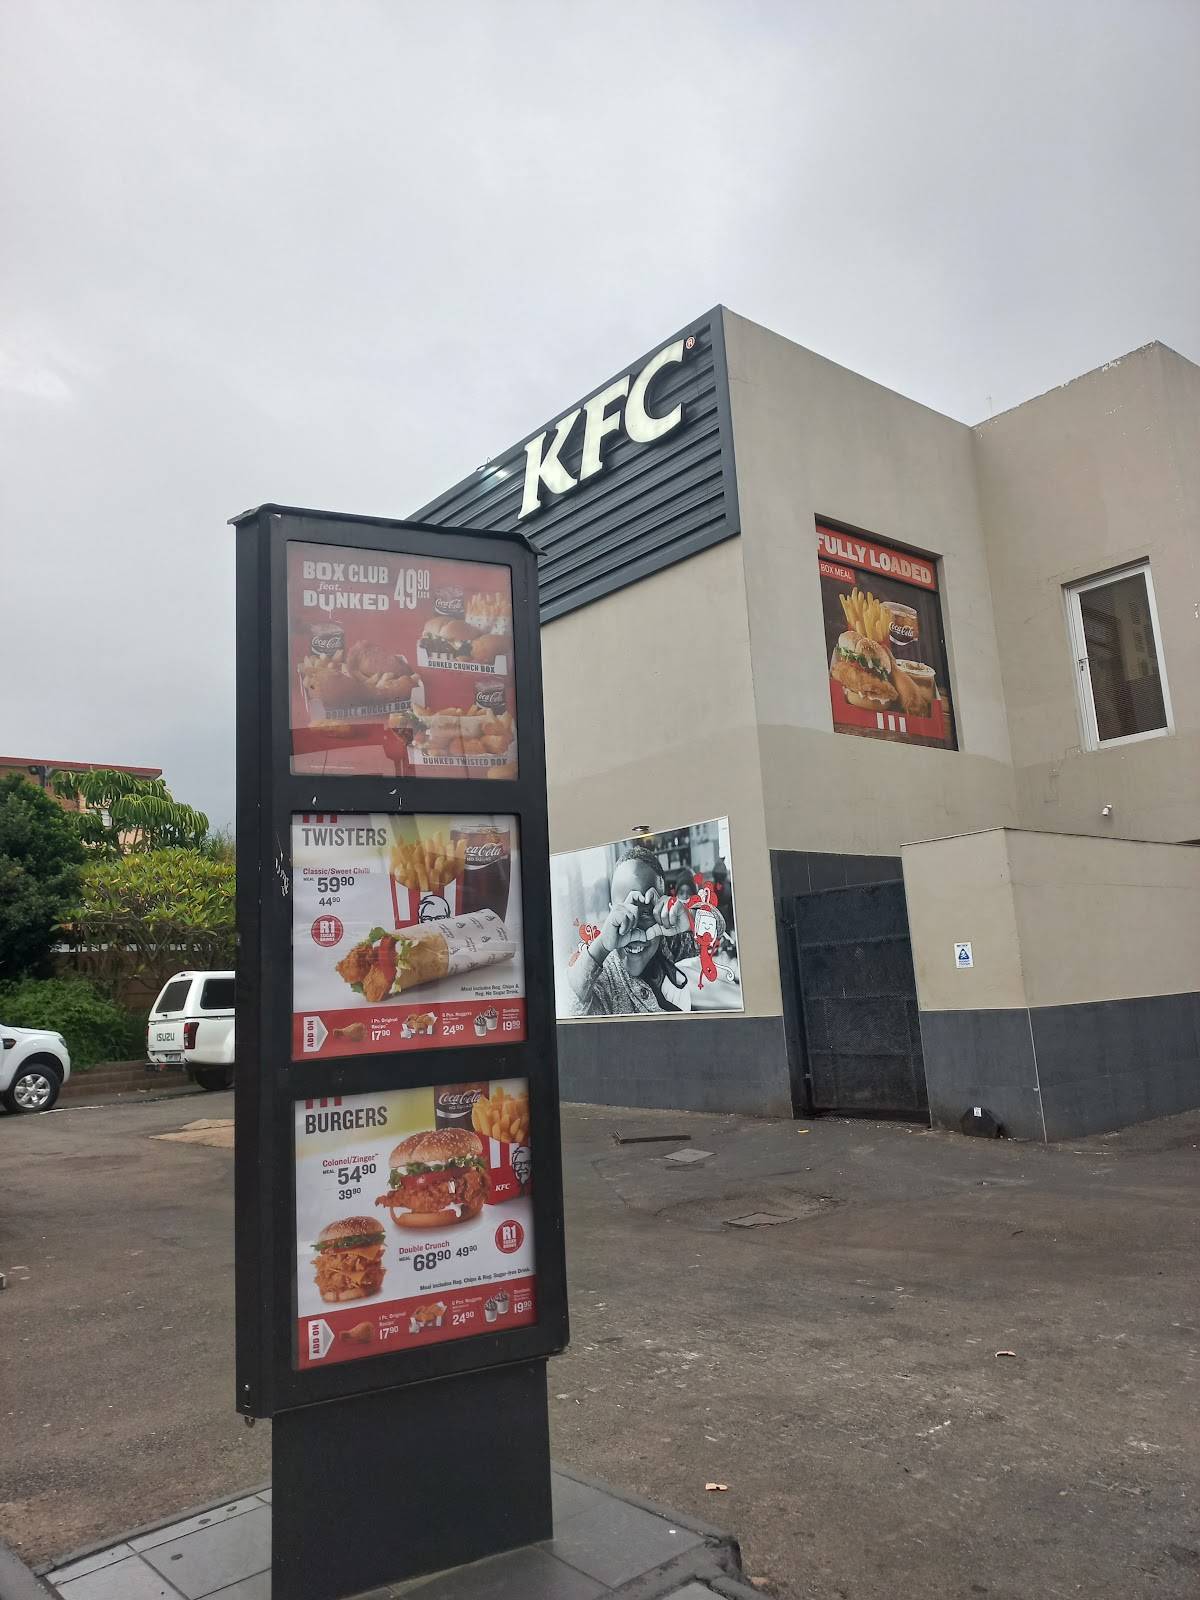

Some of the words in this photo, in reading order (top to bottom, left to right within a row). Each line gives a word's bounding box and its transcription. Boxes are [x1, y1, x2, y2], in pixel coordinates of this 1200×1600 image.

[518, 338, 685, 521] KFC
[816, 531, 868, 564] FULLY
[869, 549, 932, 585] LOADED
[302, 560, 346, 581] BOX
[348, 564, 389, 584] CLUB
[820, 563, 834, 575] BOX
[834, 568, 852, 580] MEAL
[318, 581, 342, 592] feat.
[303, 589, 390, 613] DUNKED
[453, 661, 479, 671] CRUNCH
[480, 664, 496, 673] BOX
[490, 757, 508, 766] BOX
[302, 827, 387, 847] TWISTERS
[303, 867, 352, 876] Classic/Sweet
[306, 1020, 314, 1032] ON
[157, 1032, 175, 1042] ISUZU
[306, 1033, 314, 1048] ADD
[305, 1105, 388, 1135] BURGERS
[495, 1183, 511, 1192] KFC
[399, 1243, 423, 1256] Double
[424, 1239, 450, 1252] Crunch
[312, 1324, 320, 1336] ON
[312, 1338, 320, 1354] ADD
